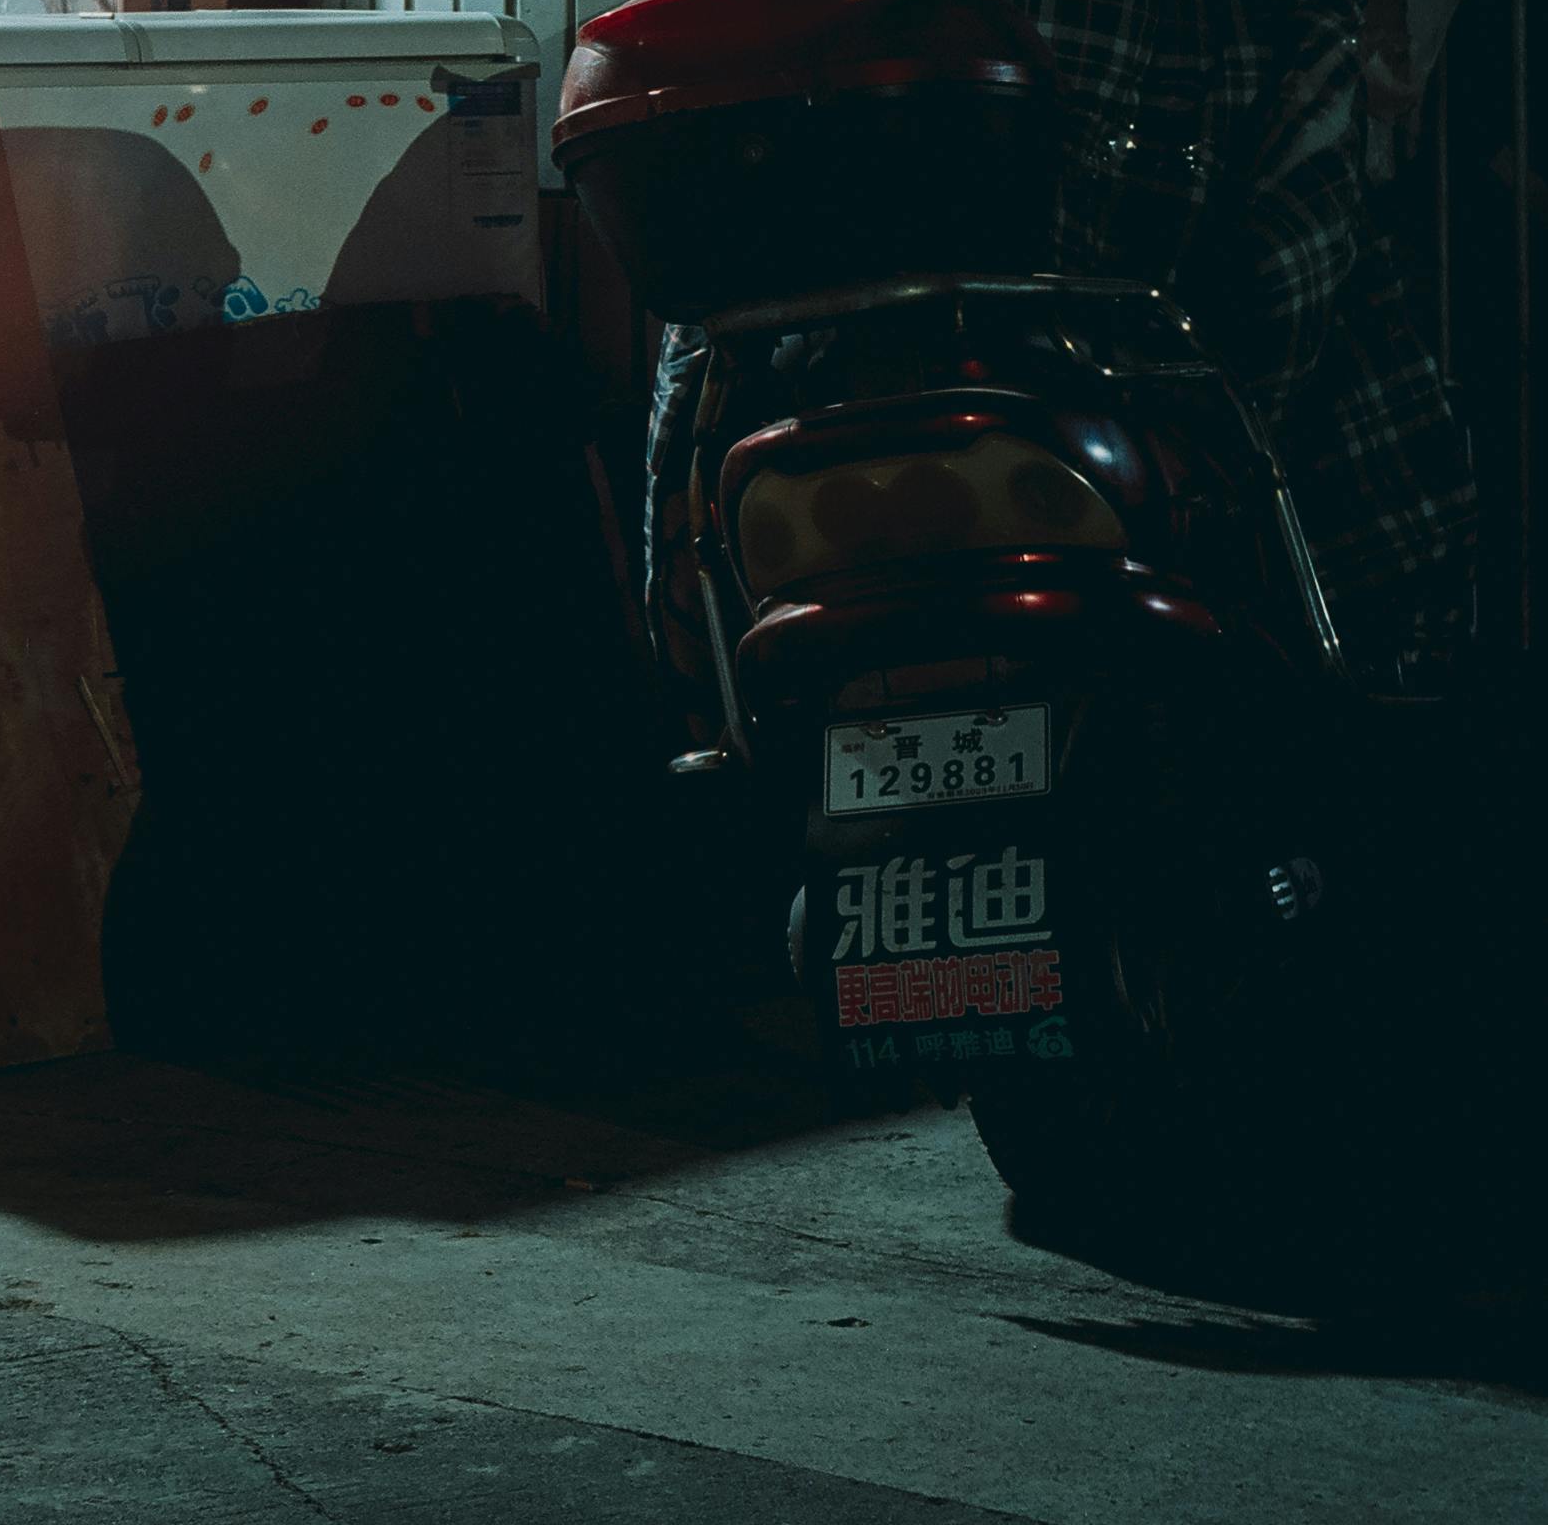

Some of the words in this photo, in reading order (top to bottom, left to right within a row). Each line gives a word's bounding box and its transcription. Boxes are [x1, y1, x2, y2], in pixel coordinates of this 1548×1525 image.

[848, 751, 1026, 799] 129881
[831, 846, 1053, 961] 雅迪
[835, 949, 1064, 1027] 更高端的电动车
[845, 1036, 902, 1069] 114
